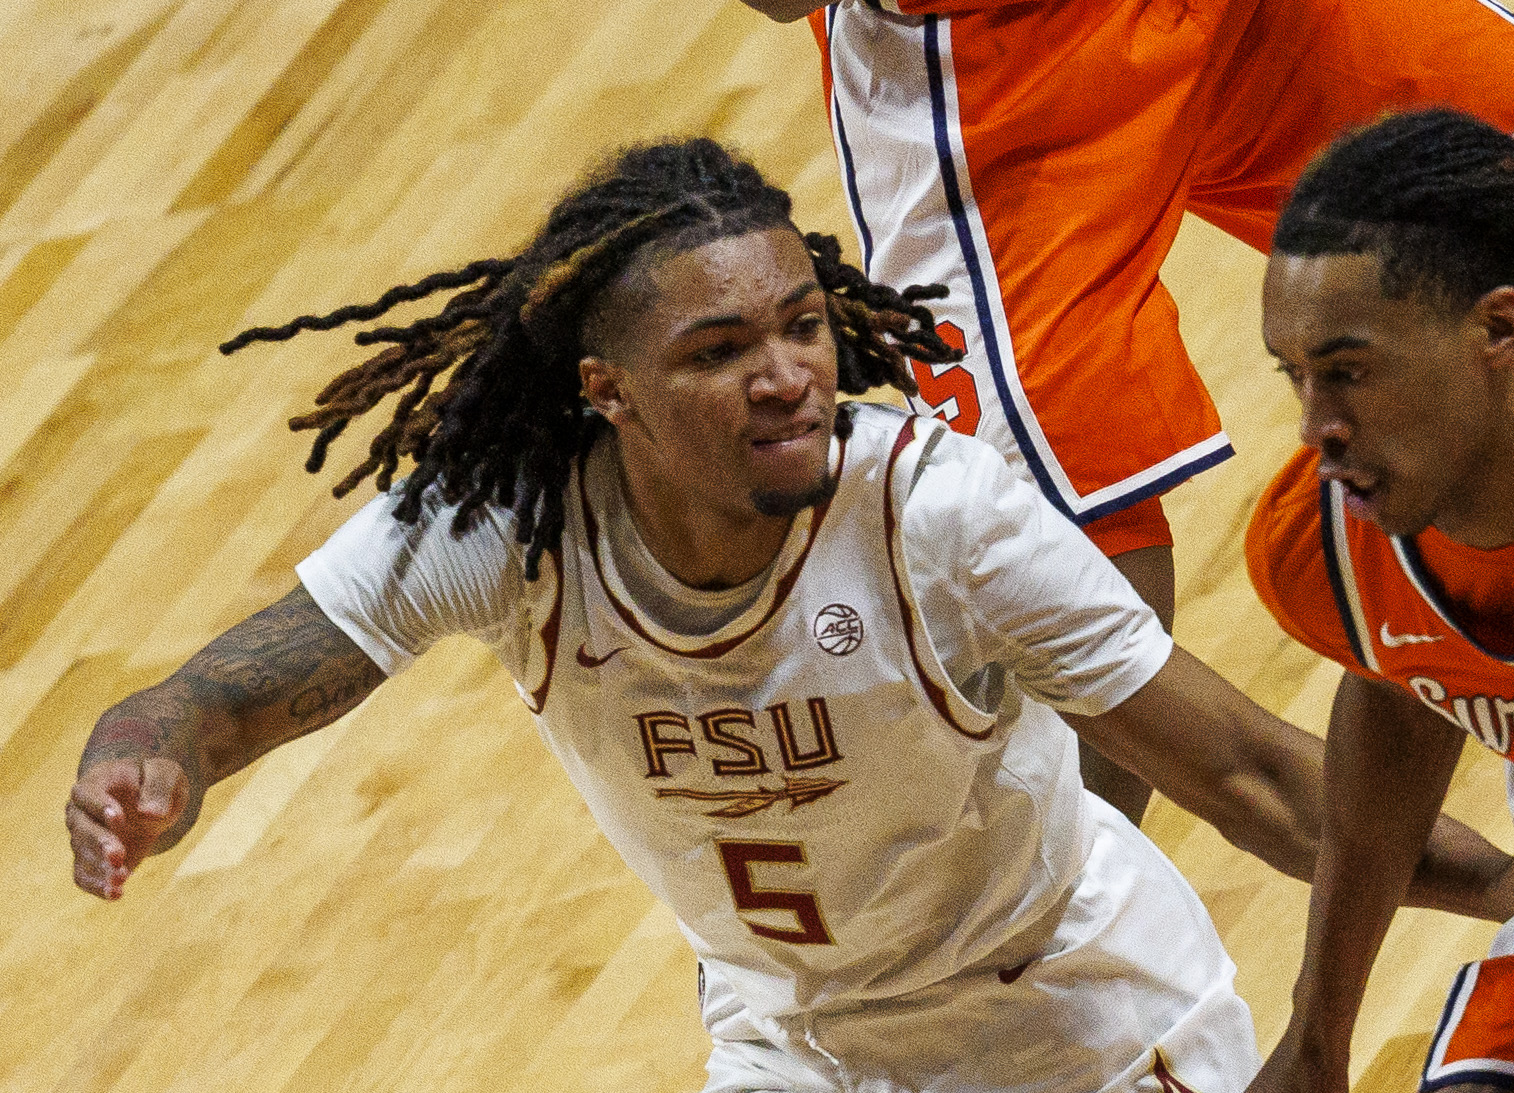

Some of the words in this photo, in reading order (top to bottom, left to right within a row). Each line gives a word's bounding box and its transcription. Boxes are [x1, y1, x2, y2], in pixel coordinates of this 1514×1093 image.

[820, 617, 860, 635] ACC
[633, 697, 843, 778] FSU
[717, 837, 837, 946] 5
